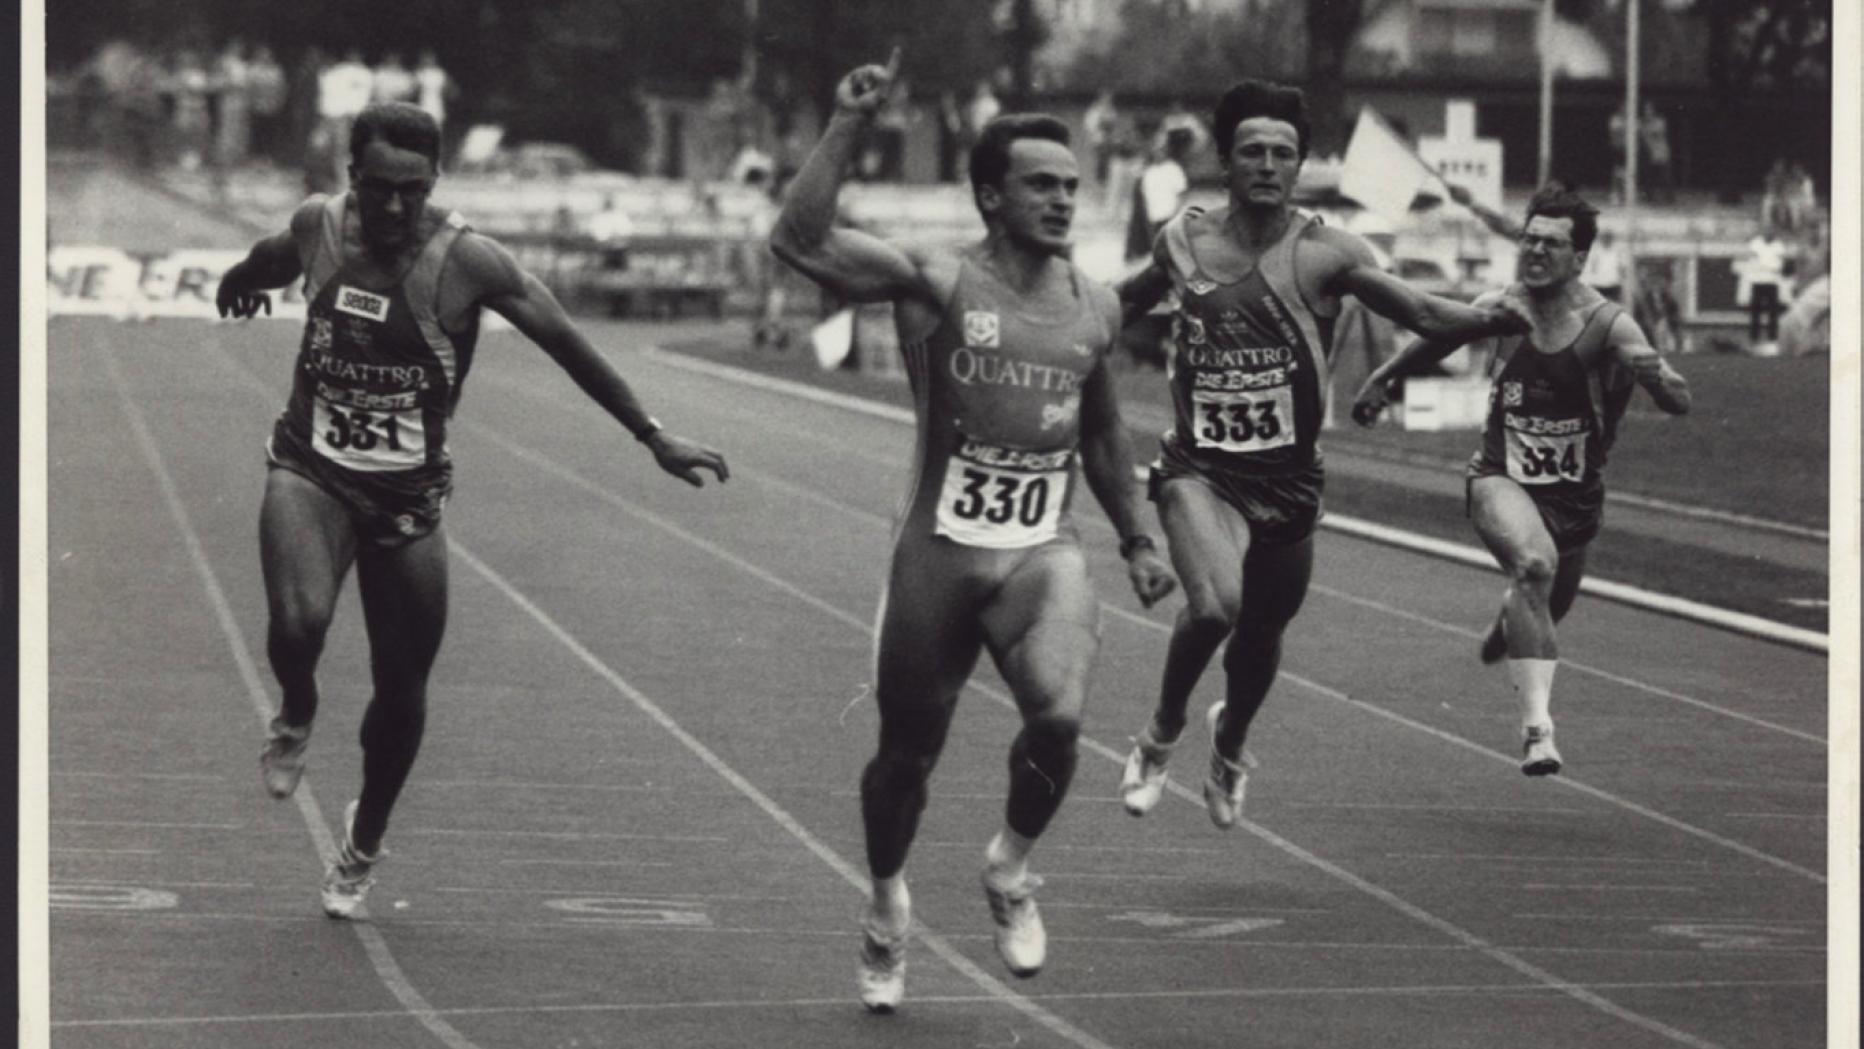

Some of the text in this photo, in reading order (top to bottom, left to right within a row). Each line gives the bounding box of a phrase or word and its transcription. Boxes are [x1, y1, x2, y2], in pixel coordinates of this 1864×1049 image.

[309, 348, 425, 383] QUATTRO
[1187, 346, 1292, 368] QUATTRO
[326, 404, 401, 451] 331
[1201, 400, 1280, 442] 333
[953, 467, 1049, 527] 330
